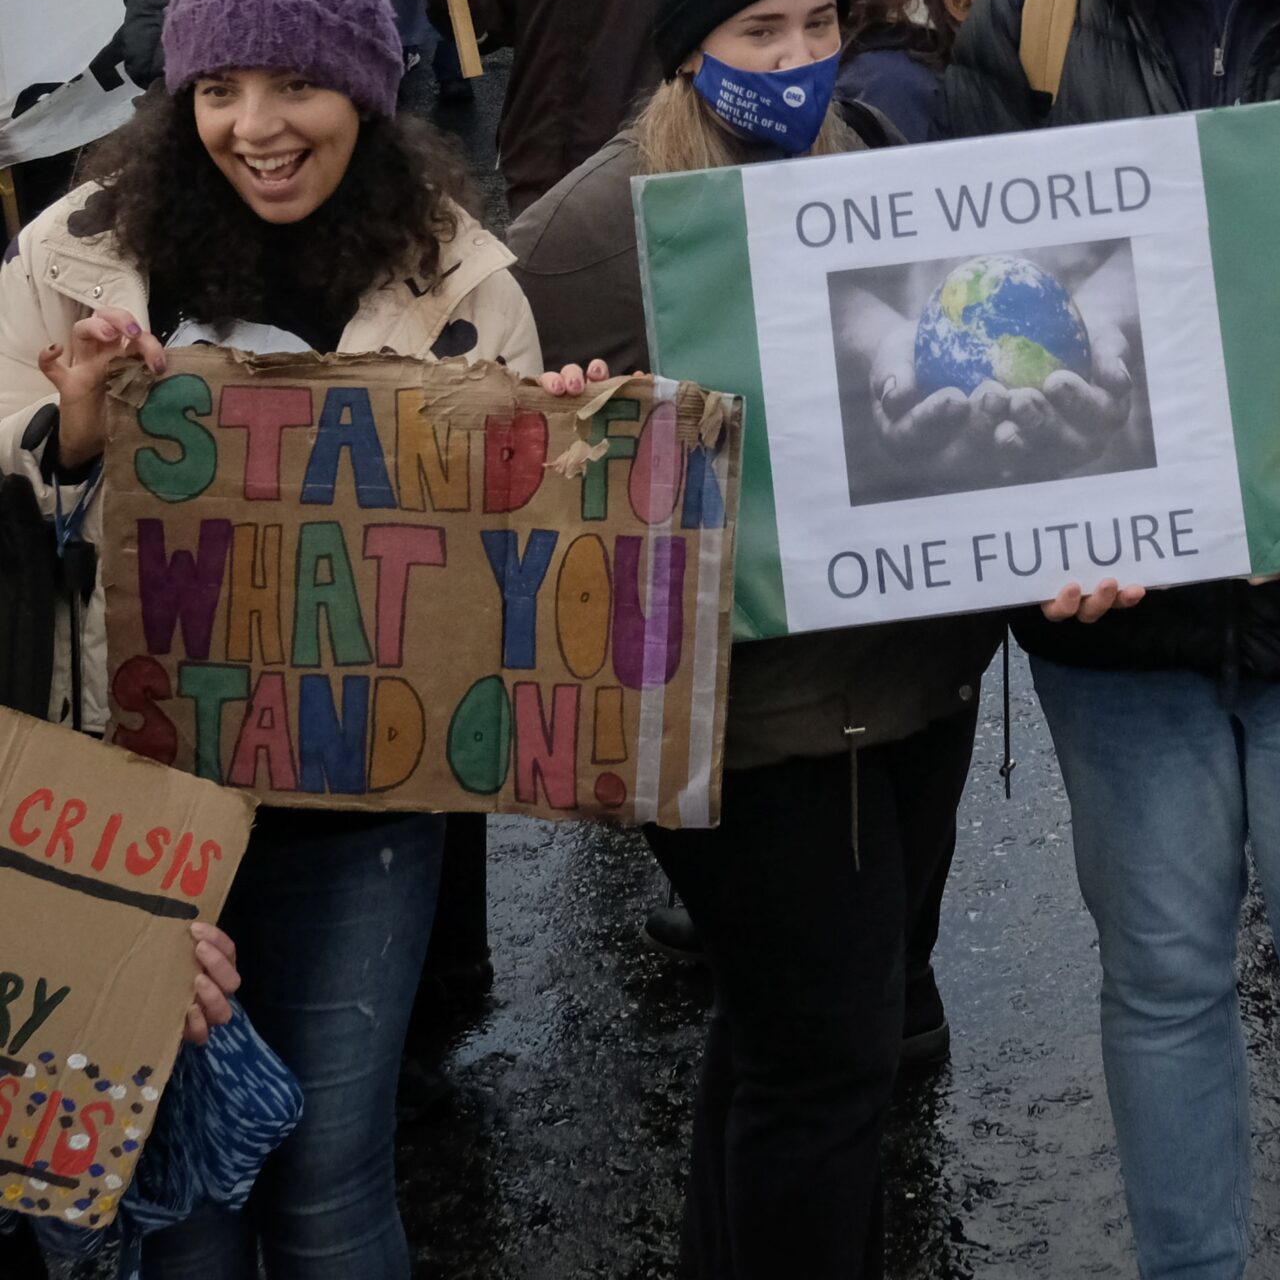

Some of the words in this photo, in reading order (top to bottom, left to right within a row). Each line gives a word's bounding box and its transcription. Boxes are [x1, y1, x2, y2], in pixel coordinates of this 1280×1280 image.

[716, 99, 741, 119] UNTIL
[743, 111, 759, 125] ALL
[761, 119, 774, 131] OF
[774, 121, 788, 134] US
[721, 77, 745, 98] NONE
[746, 89, 758, 101] OF
[735, 96, 759, 113] SAFE
[795, 190, 918, 249] ONE
[934, 165, 1152, 233] WORLD
[134, 372, 549, 515] STAND
[827, 539, 951, 600] ONE
[971, 507, 1199, 582] FUTURE
[136, 517, 447, 669] WHAT
[480, 528, 686, 691] YOU
[112, 655, 426, 794] STAND
[9, 787, 222, 898] CRISIS
